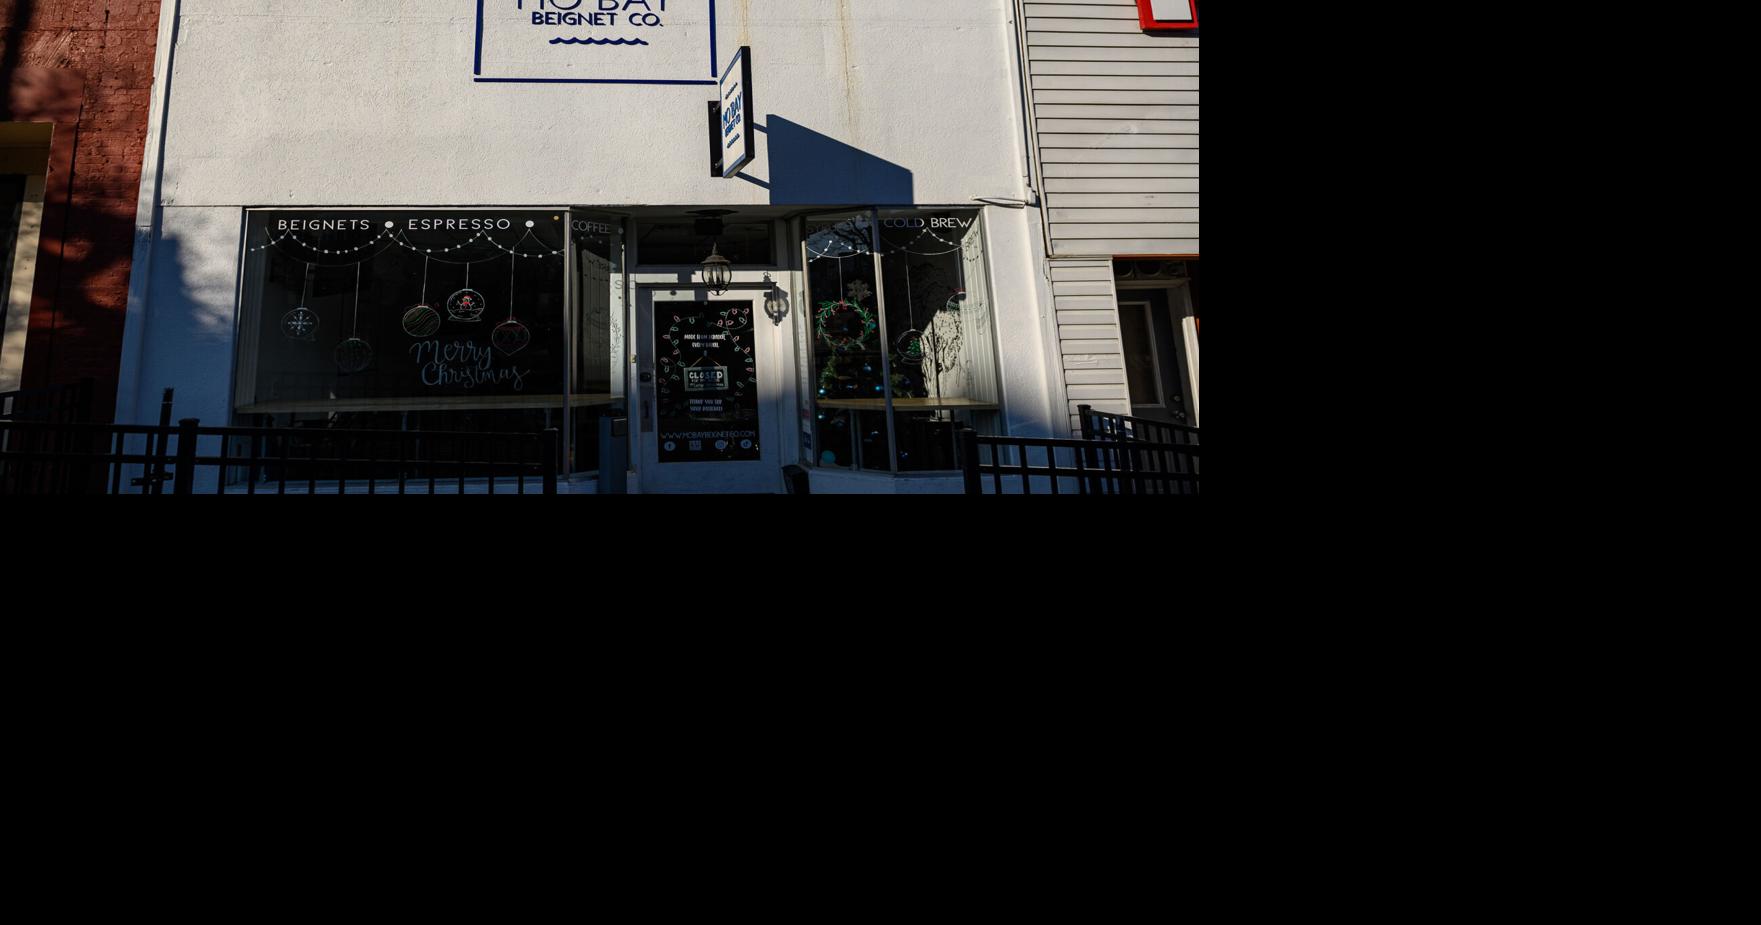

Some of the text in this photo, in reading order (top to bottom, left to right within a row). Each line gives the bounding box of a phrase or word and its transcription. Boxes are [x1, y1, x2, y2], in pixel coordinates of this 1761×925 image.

[531, 11, 664, 27] BEIGNET CO.
[730, 91, 742, 118] BAY
[278, 218, 511, 230] BEIGNETS ESPRESSO
[571, 219, 611, 234] COFFEE
[883, 217, 972, 228] COLD BREW
[408, 339, 492, 370] Merry
[421, 360, 531, 391] Christmas
[689, 371, 723, 379] CLOSED
